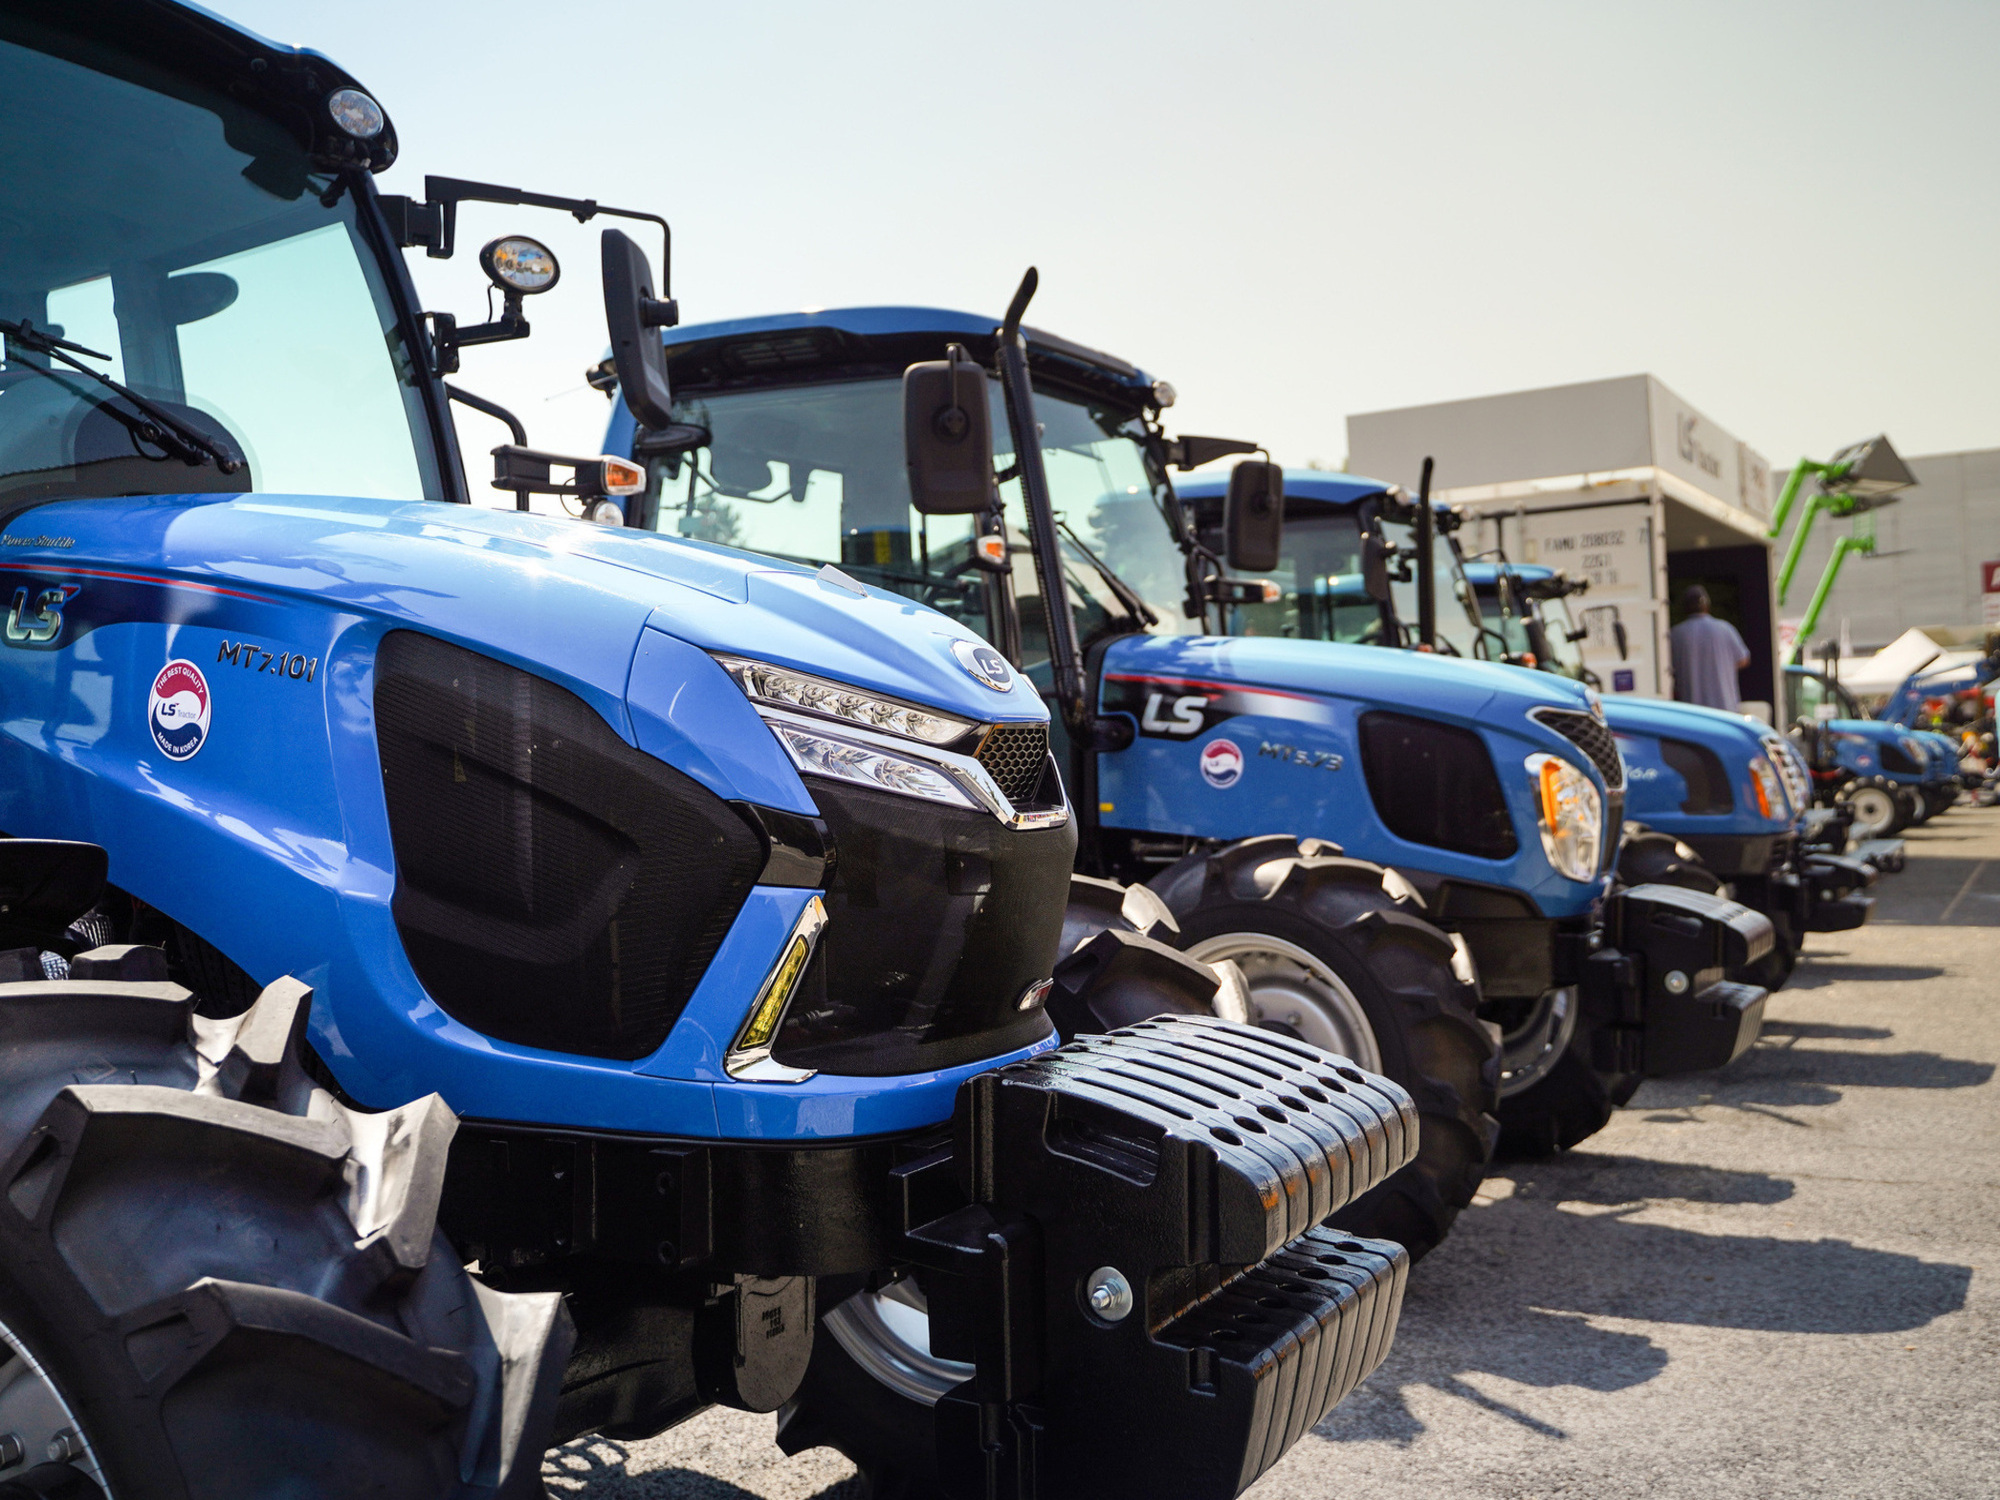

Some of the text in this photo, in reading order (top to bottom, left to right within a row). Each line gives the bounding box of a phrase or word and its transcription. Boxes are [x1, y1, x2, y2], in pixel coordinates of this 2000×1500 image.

[6, 590, 65, 641] LS
[217, 640, 318, 682] MT7.101
[980, 658, 1004, 675] LS
[157, 666, 204, 694] THE BEST QUALITY
[161, 703, 197, 719] LS Tractor
[1141, 693, 1208, 735] LS
[157, 731, 199, 754] MADE IN KOREA
[1258, 741, 1343, 771] MT5.73
